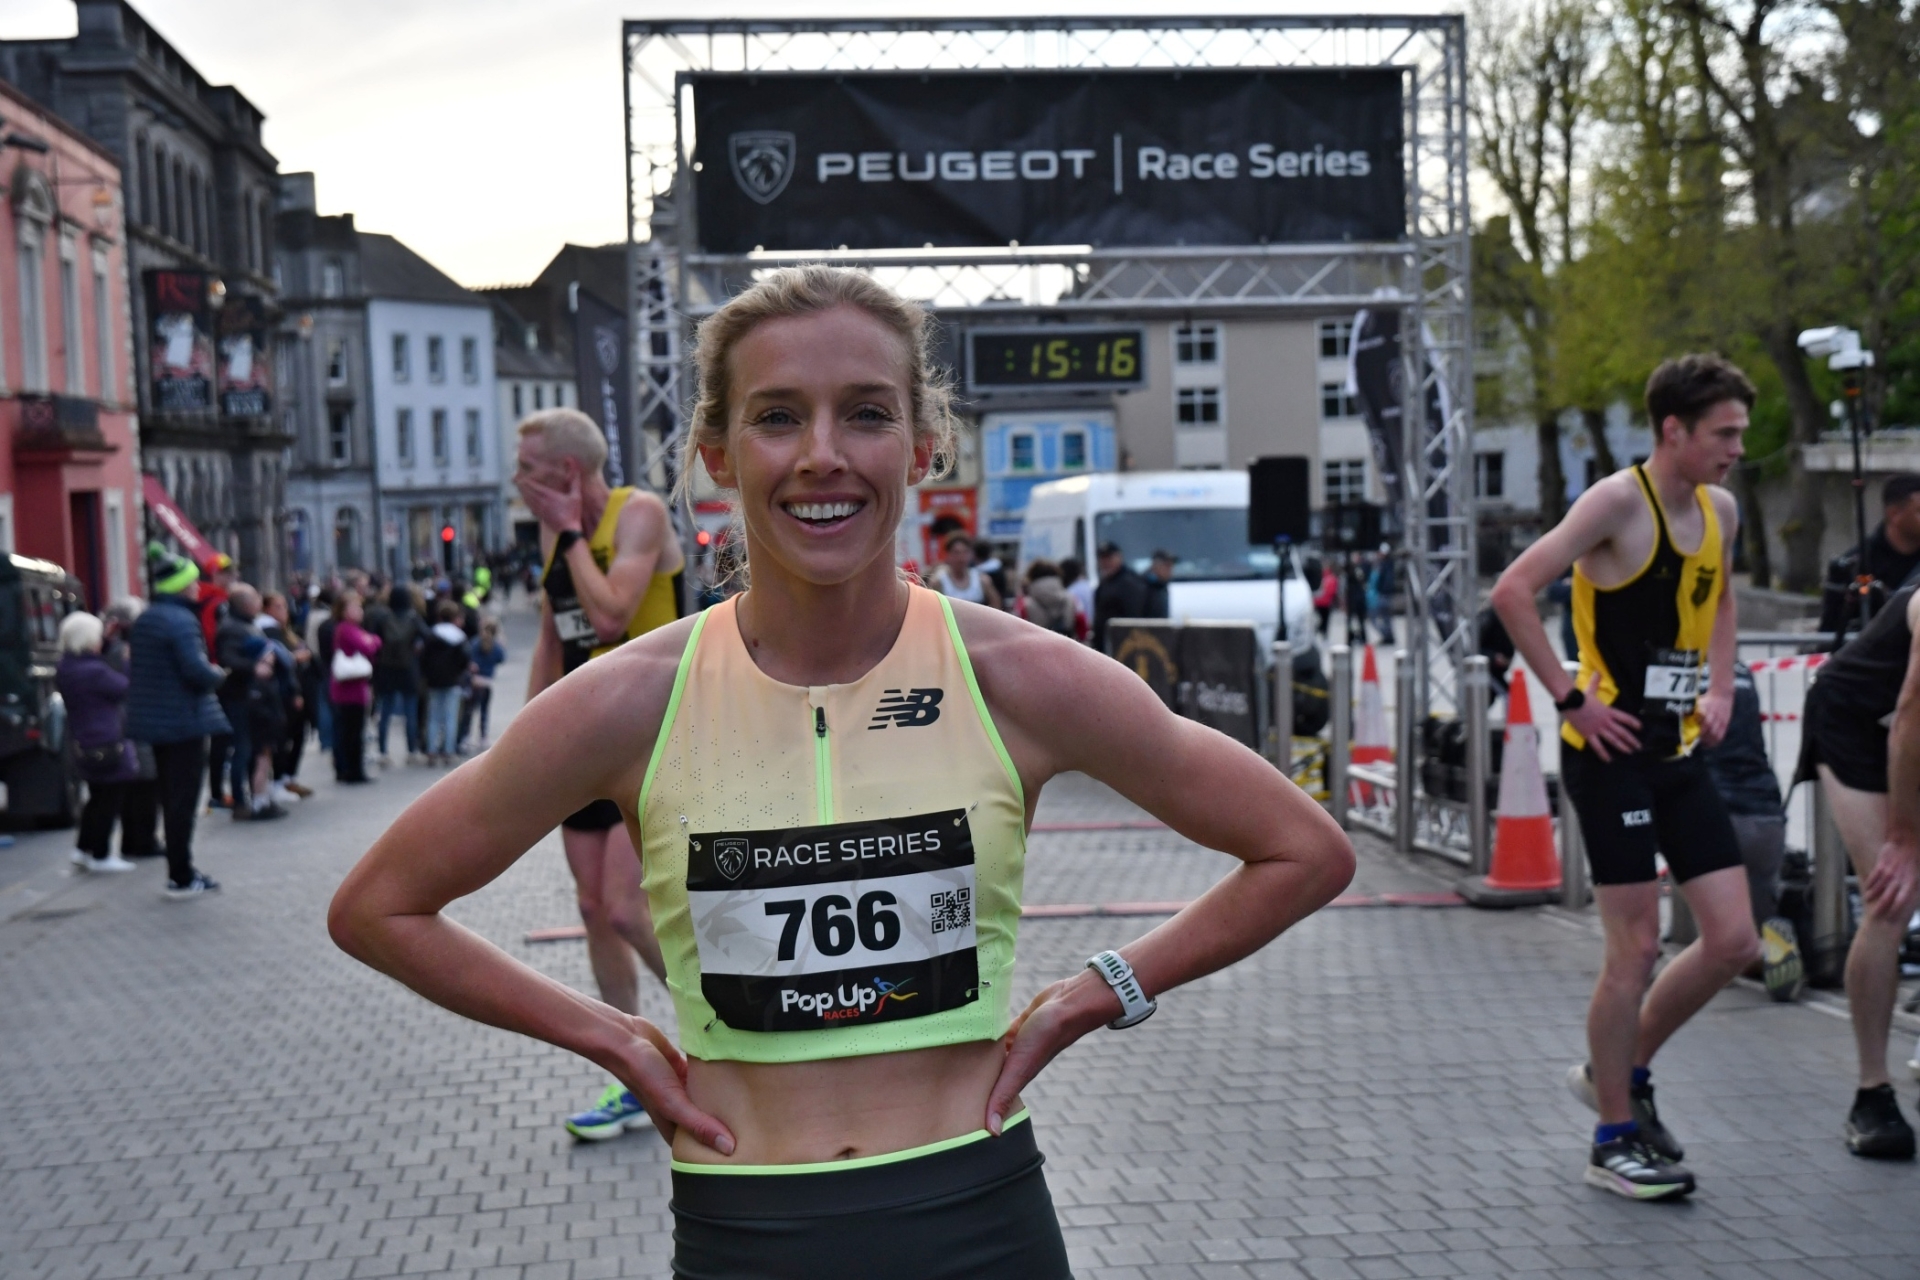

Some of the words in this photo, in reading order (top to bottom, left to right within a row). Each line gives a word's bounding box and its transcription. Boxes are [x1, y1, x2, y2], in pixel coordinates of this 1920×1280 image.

[817, 150, 1097, 183] PEUGEOT
[1137, 147, 1239, 180] Race
[1248, 143, 1371, 177] Series
[602, 376, 625, 488] UGEOT
[754, 842, 831, 869] RACE
[839, 829, 942, 861] SERIES
[764, 890, 901, 962] 766
[780, 989, 834, 1017] Pop
[837, 982, 877, 1012] Up
[823, 1007, 860, 1020] RACES
